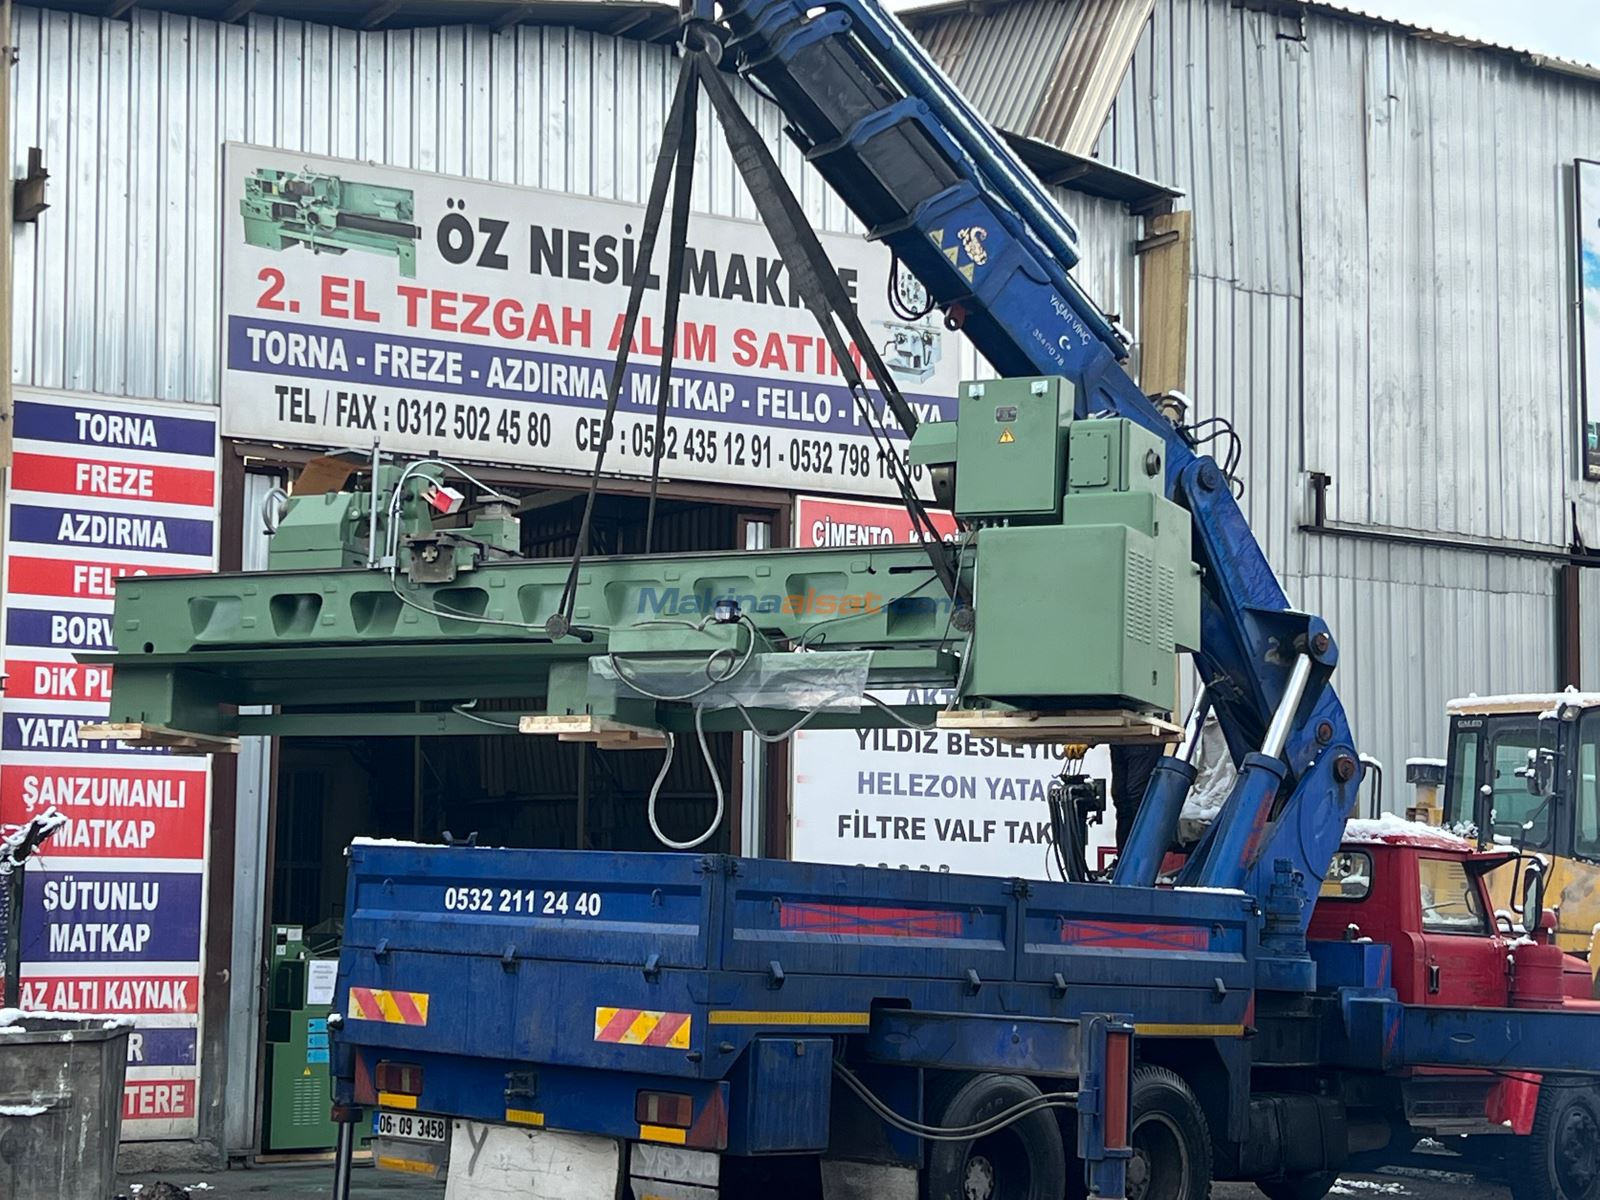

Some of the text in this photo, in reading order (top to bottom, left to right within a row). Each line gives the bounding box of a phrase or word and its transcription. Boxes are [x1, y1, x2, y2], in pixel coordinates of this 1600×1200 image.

[437, 198, 509, 270] ÖZ
[680, 246, 858, 317] MAKE
[256, 267, 300, 313] 2.
[321, 275, 380, 323] EL
[397, 285, 591, 348] TEZGAH
[247, 327, 348, 372] TORNA
[374, 342, 463, 384] FREZE
[486, 357, 609, 401] AZDIRMA
[757, 386, 832, 424] FELLO
[853, 396, 942, 431] PLAYA
[75, 412, 157, 447] TORNA
[275, 385, 317, 426] TEL
[336, 392, 377, 430] FAX
[396, 398, 446, 437] 0312
[454, 405, 490, 442] 502
[497, 408, 521, 445] 45
[527, 413, 551, 448] 80
[632, 422, 677, 460] 052
[684, 428, 716, 462] 435
[724, 432, 744, 465] 12
[752, 435, 771, 468] 91
[790, 438, 832, 474] 0532
[839, 443, 870, 478] 798
[76, 463, 153, 497] FREZE
[57, 513, 168, 549] AZDIRMA
[74, 565, 148, 595] FEL
[856, 729, 938, 754] YILDIZ
[23, 776, 186, 812] ŞANZUMANLI
[858, 771, 976, 799] HELEZON
[52, 819, 155, 849] MATKAP
[838, 809, 926, 840] FİLTRE
[934, 818, 996, 843] VALF
[43, 876, 159, 912] SÜTUNLU
[445, 888, 601, 916] 0532 211 24 40
[49, 923, 150, 953] MATKAP
[19, 981, 187, 1010] AZ ALTI KAYNAK
